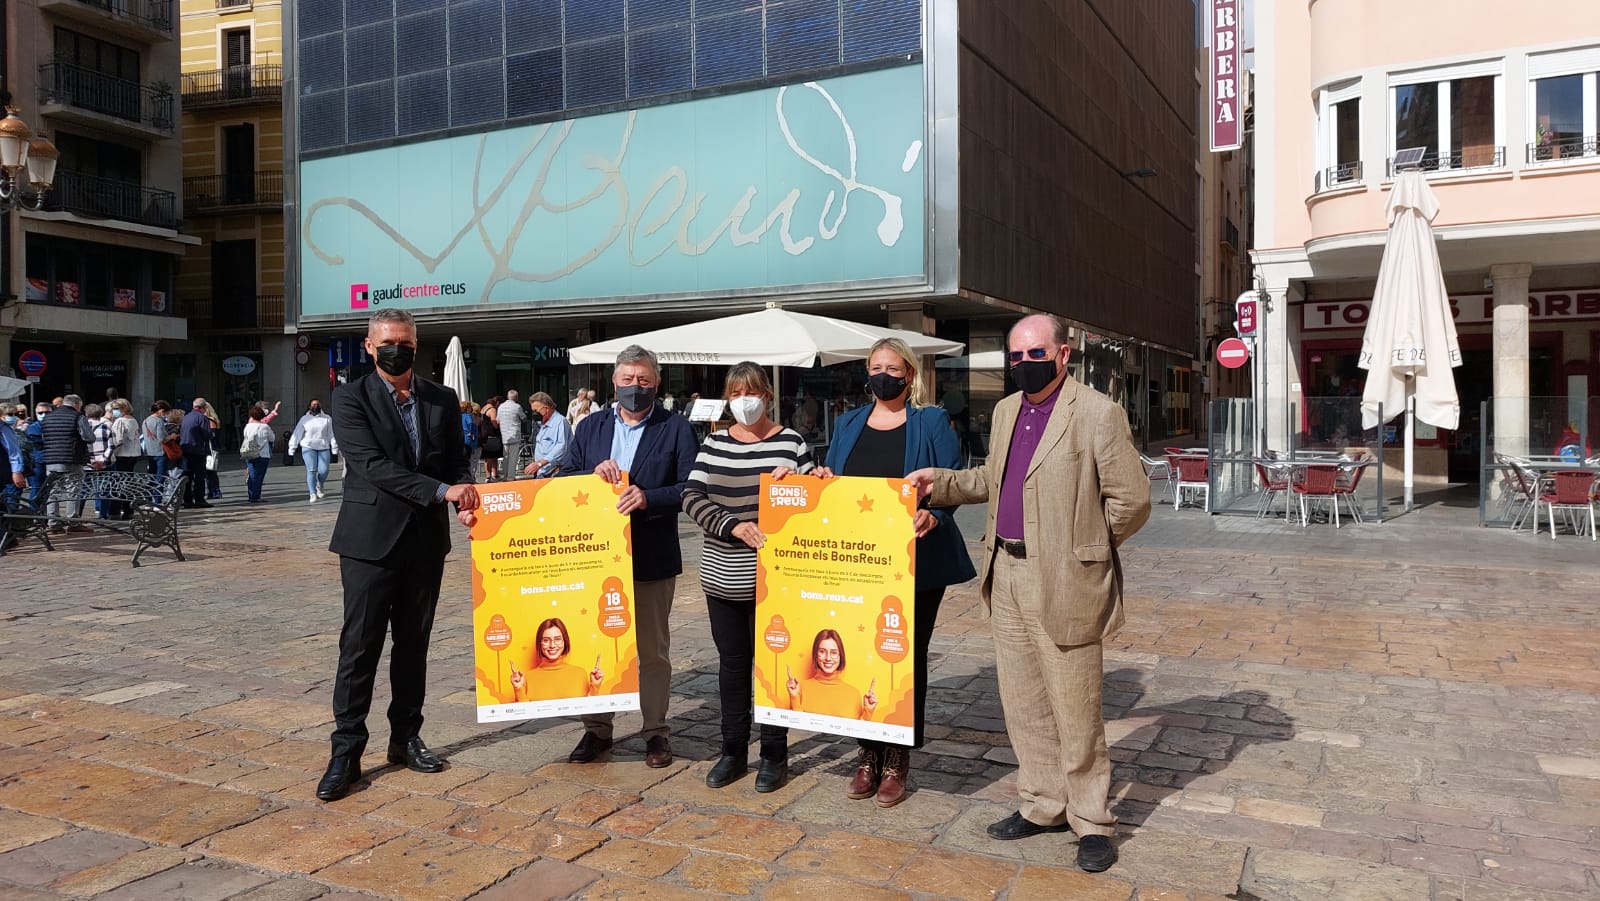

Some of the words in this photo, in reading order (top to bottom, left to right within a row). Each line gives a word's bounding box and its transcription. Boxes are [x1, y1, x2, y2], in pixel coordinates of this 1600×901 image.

[1216, 0, 1236, 124] RBERÀ
[483, 493, 514, 504] BONS
[771, 487, 800, 497] BONS
[508, 535, 556, 549] Aquesta
[558, 531, 594, 543] tardor
[792, 535, 838, 549] Aquesta
[841, 539, 876, 552] tardor
[490, 547, 528, 560] tornen
[530, 546, 547, 557] els
[549, 541, 610, 556] BonsReus!
[774, 547, 810, 560] tornen
[812, 549, 829, 561] els
[831, 550, 892, 566] BonsReus!
[520, 581, 585, 595] bons.reus.cat
[800, 588, 864, 604] bons.reus.cat
[605, 592, 621, 606] 18
[884, 613, 900, 628] 18
